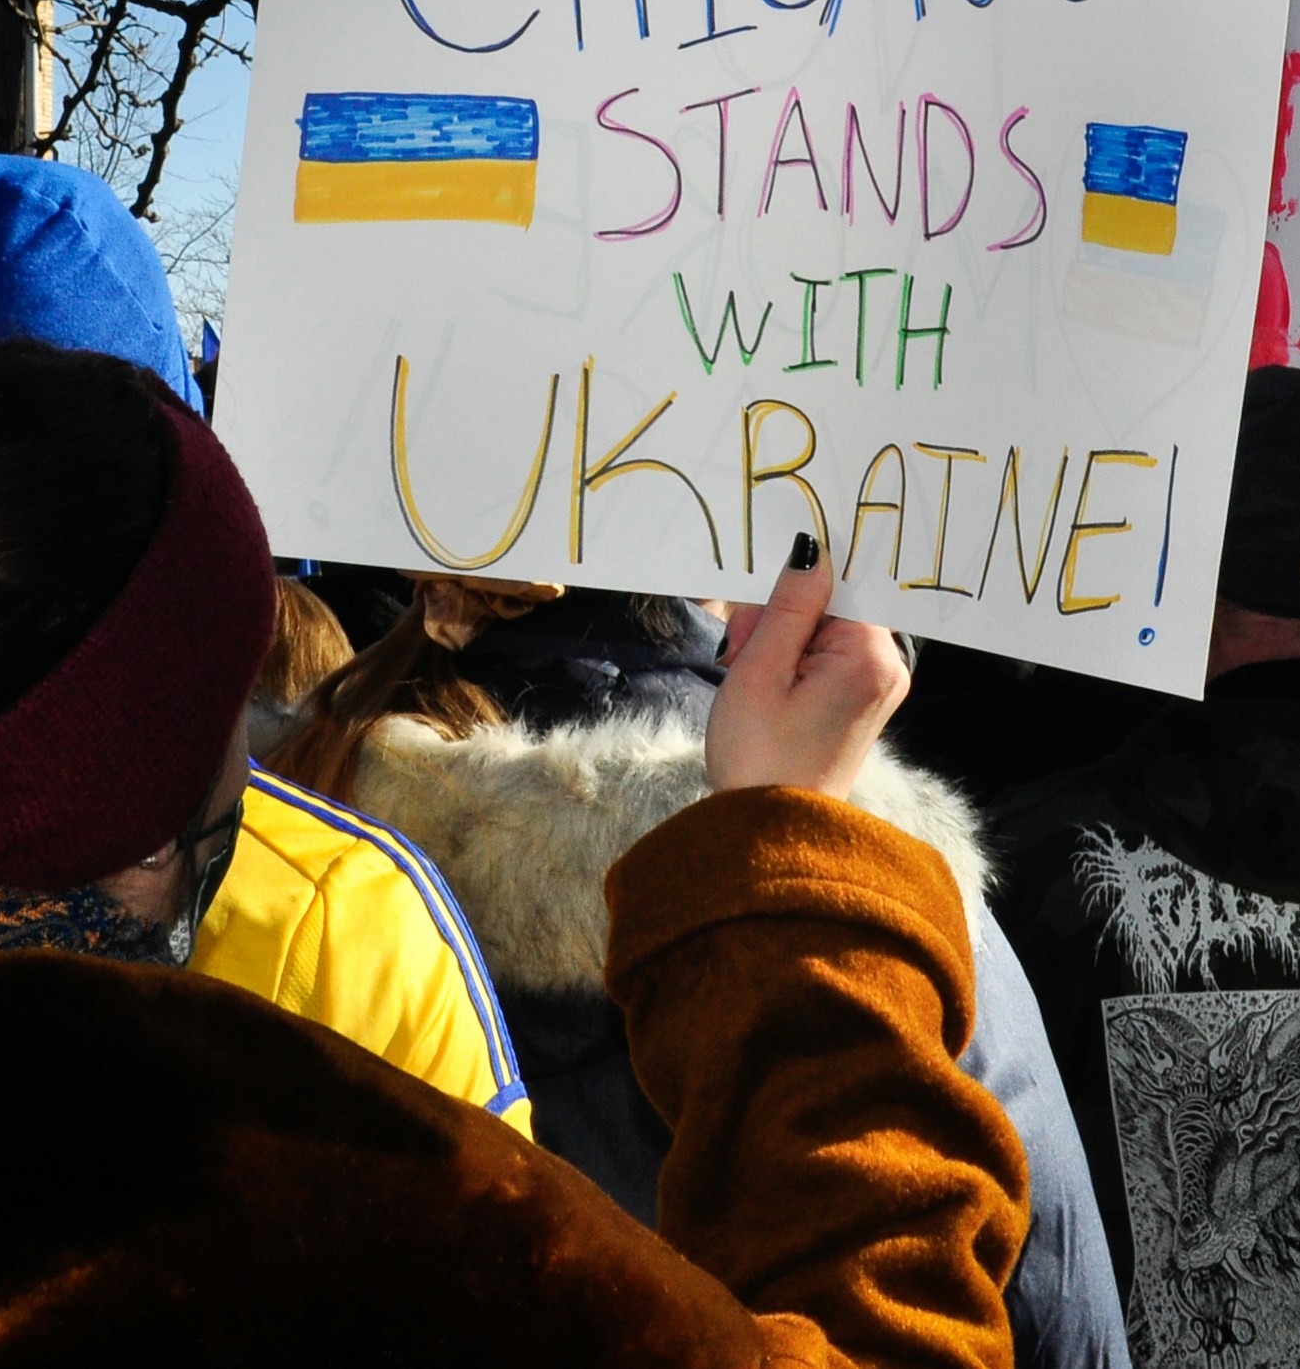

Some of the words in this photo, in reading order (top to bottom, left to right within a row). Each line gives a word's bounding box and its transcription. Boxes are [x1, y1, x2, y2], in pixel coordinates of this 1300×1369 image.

[593, 86, 1048, 252] STANDS
[672, 268, 953, 390] WITH
[389, 353, 1179, 647] UKRAINE!
